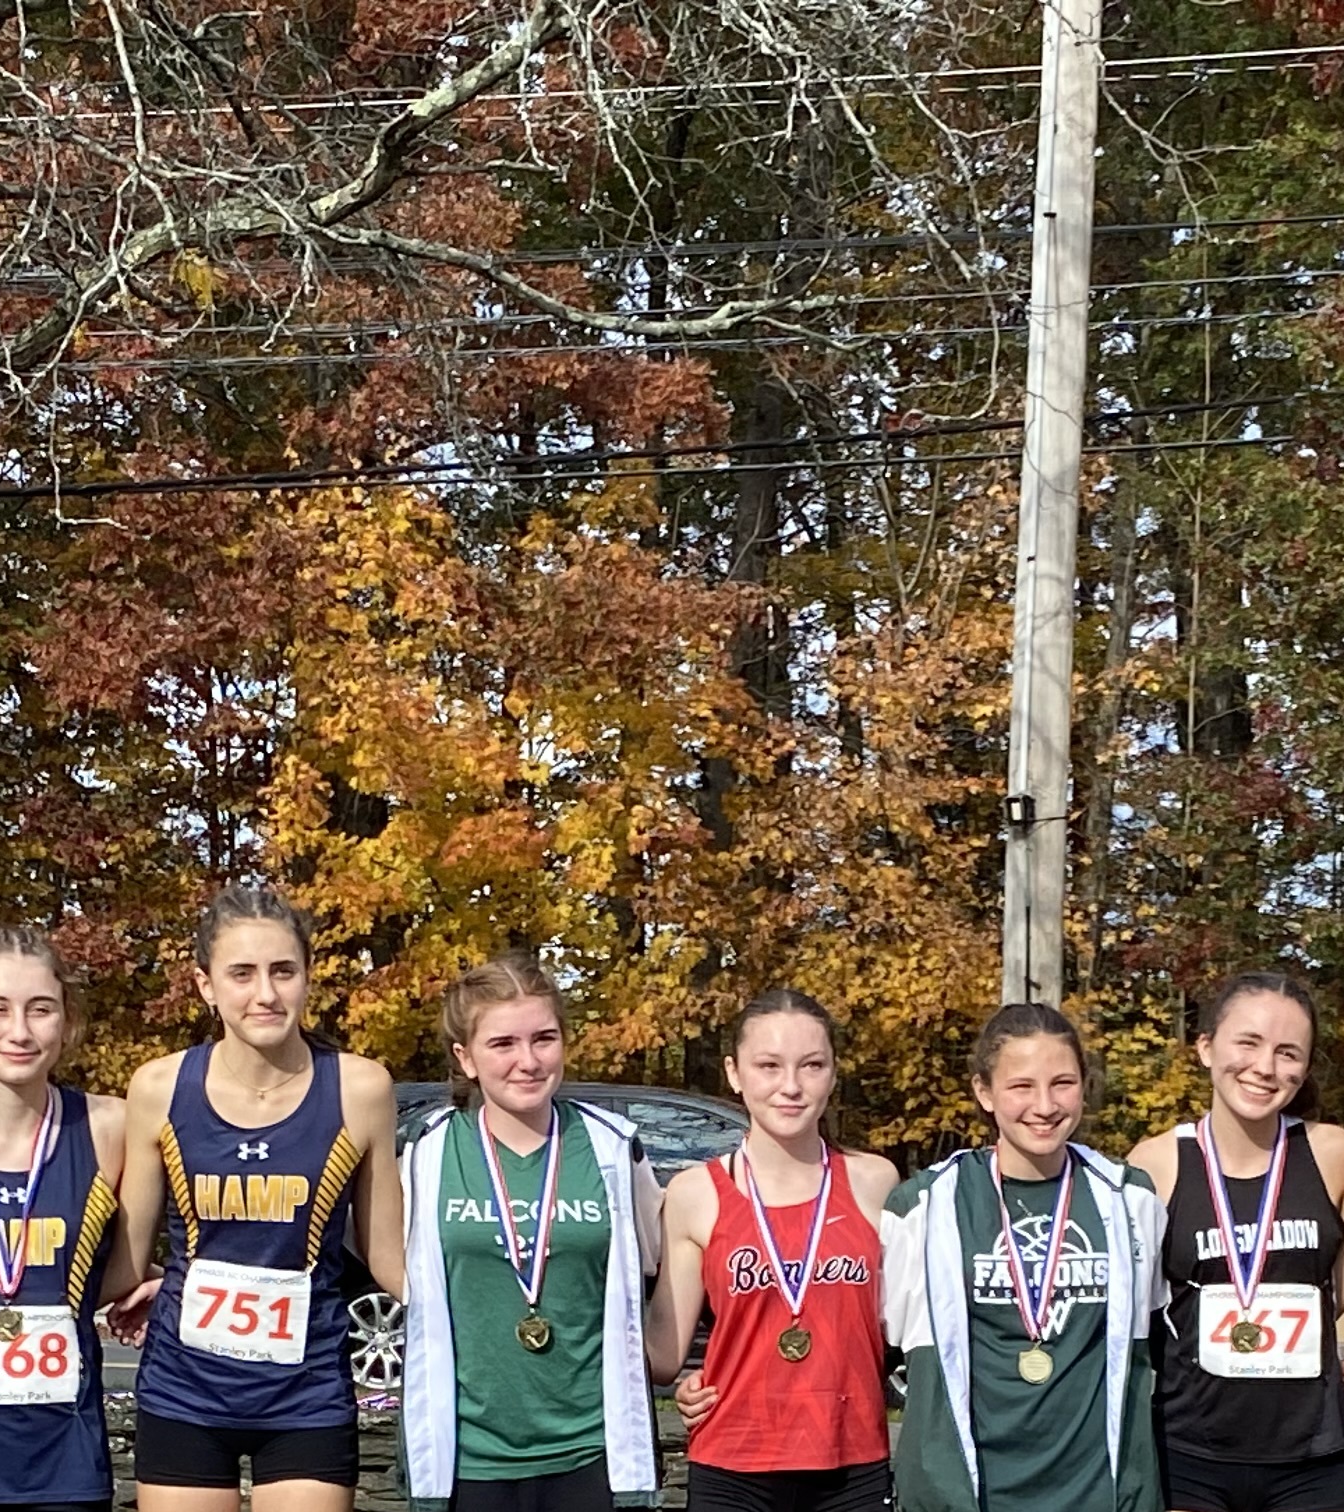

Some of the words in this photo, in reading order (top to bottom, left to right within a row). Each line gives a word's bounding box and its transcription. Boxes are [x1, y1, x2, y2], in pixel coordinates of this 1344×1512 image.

[194, 1173, 309, 1223] HAMP
[445, 1198, 602, 1223] FALCONS
[1195, 1219, 1319, 1261] LOGMADOW
[727, 1245, 871, 1297] Bomers
[973, 1260, 1109, 1287] FACONS
[196, 1286, 294, 1341] 751
[1210, 1310, 1310, 1354] 467
